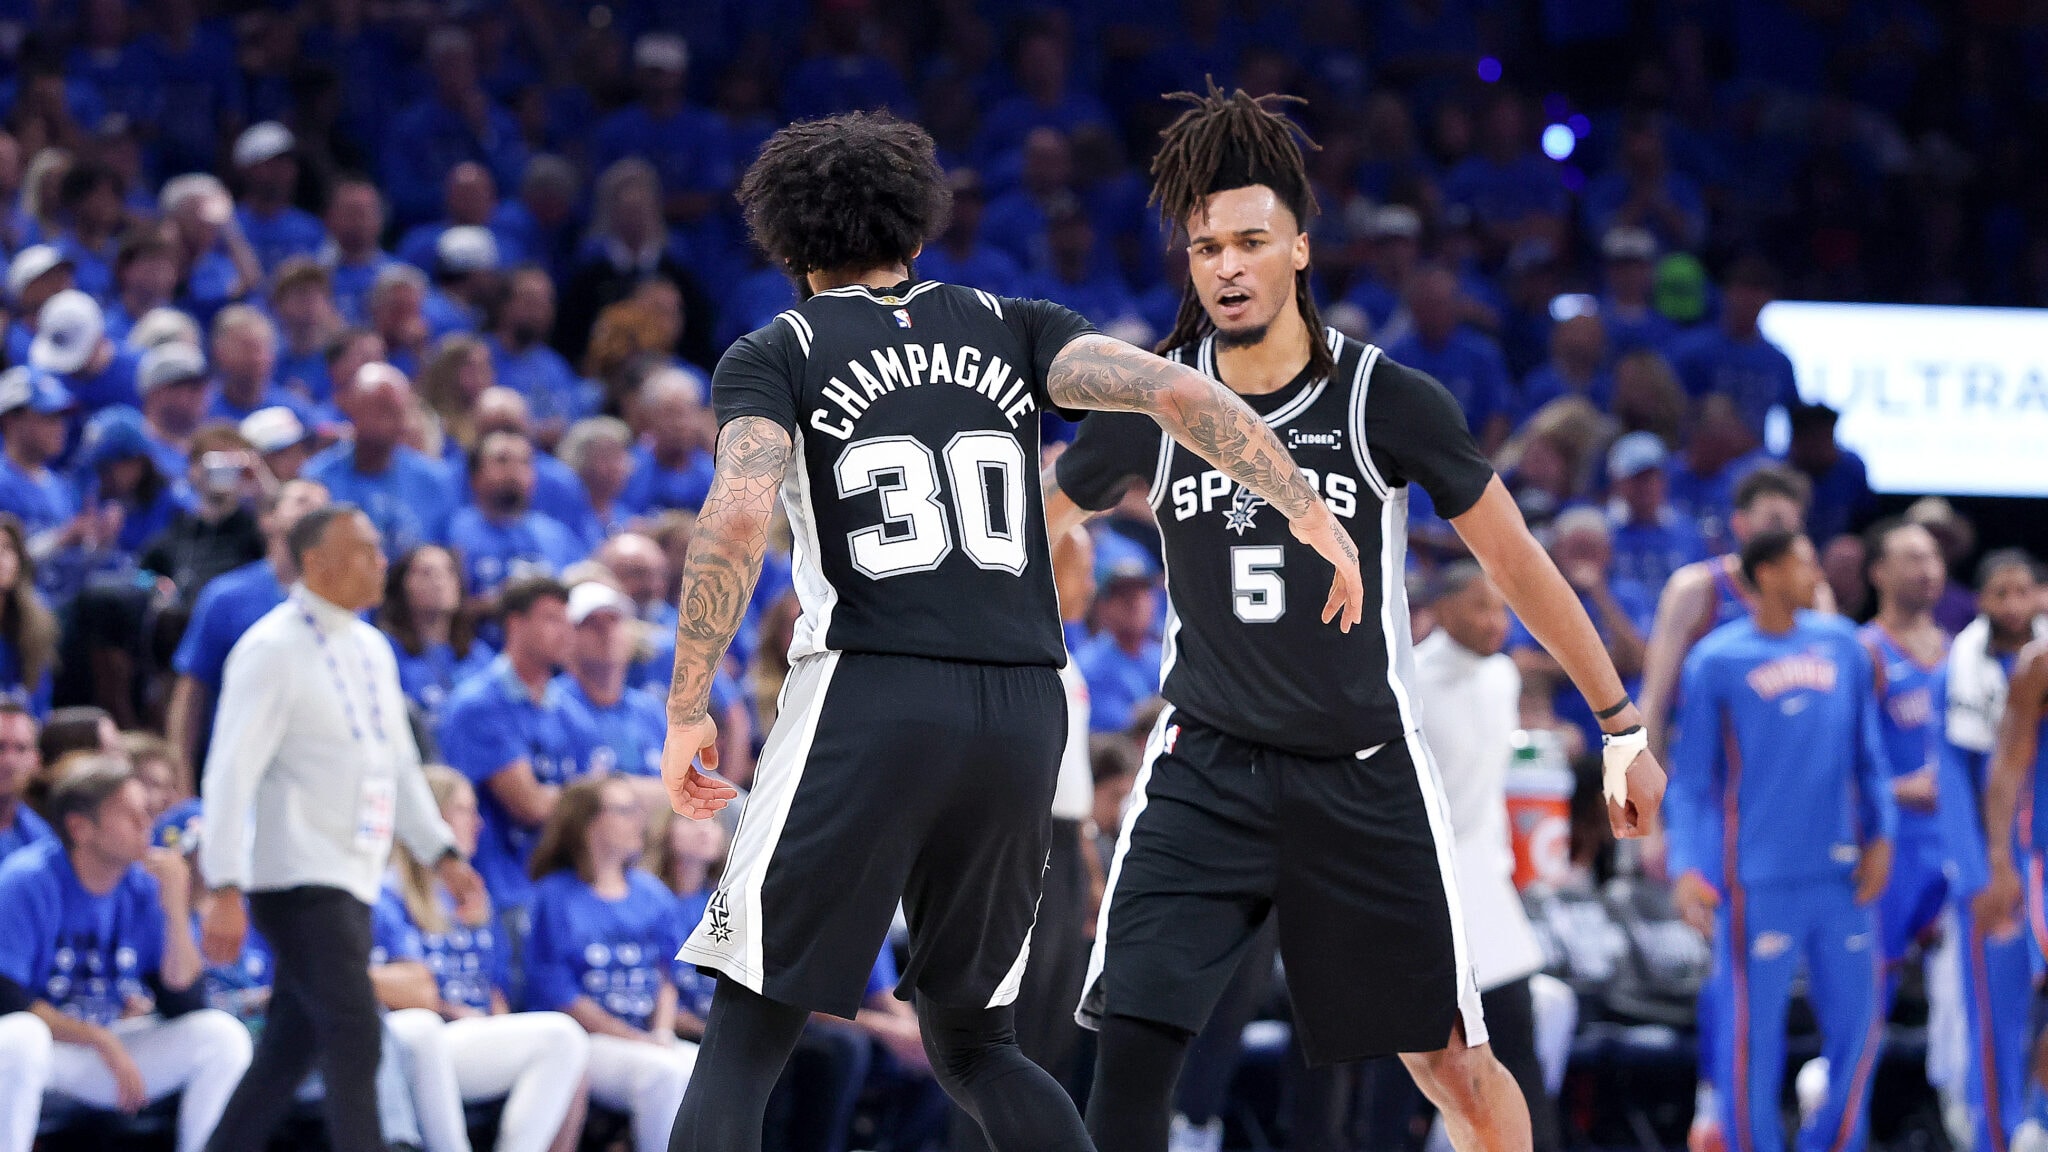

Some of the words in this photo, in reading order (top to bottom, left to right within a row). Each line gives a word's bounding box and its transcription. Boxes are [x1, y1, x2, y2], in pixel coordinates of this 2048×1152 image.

[810, 342, 1036, 441] CHAMPAGNIE
[1294, 433, 1335, 445] LEDGER
[833, 430, 1029, 581] 30
[1171, 467, 1358, 530] SPS
[1230, 544, 1286, 624] 5
